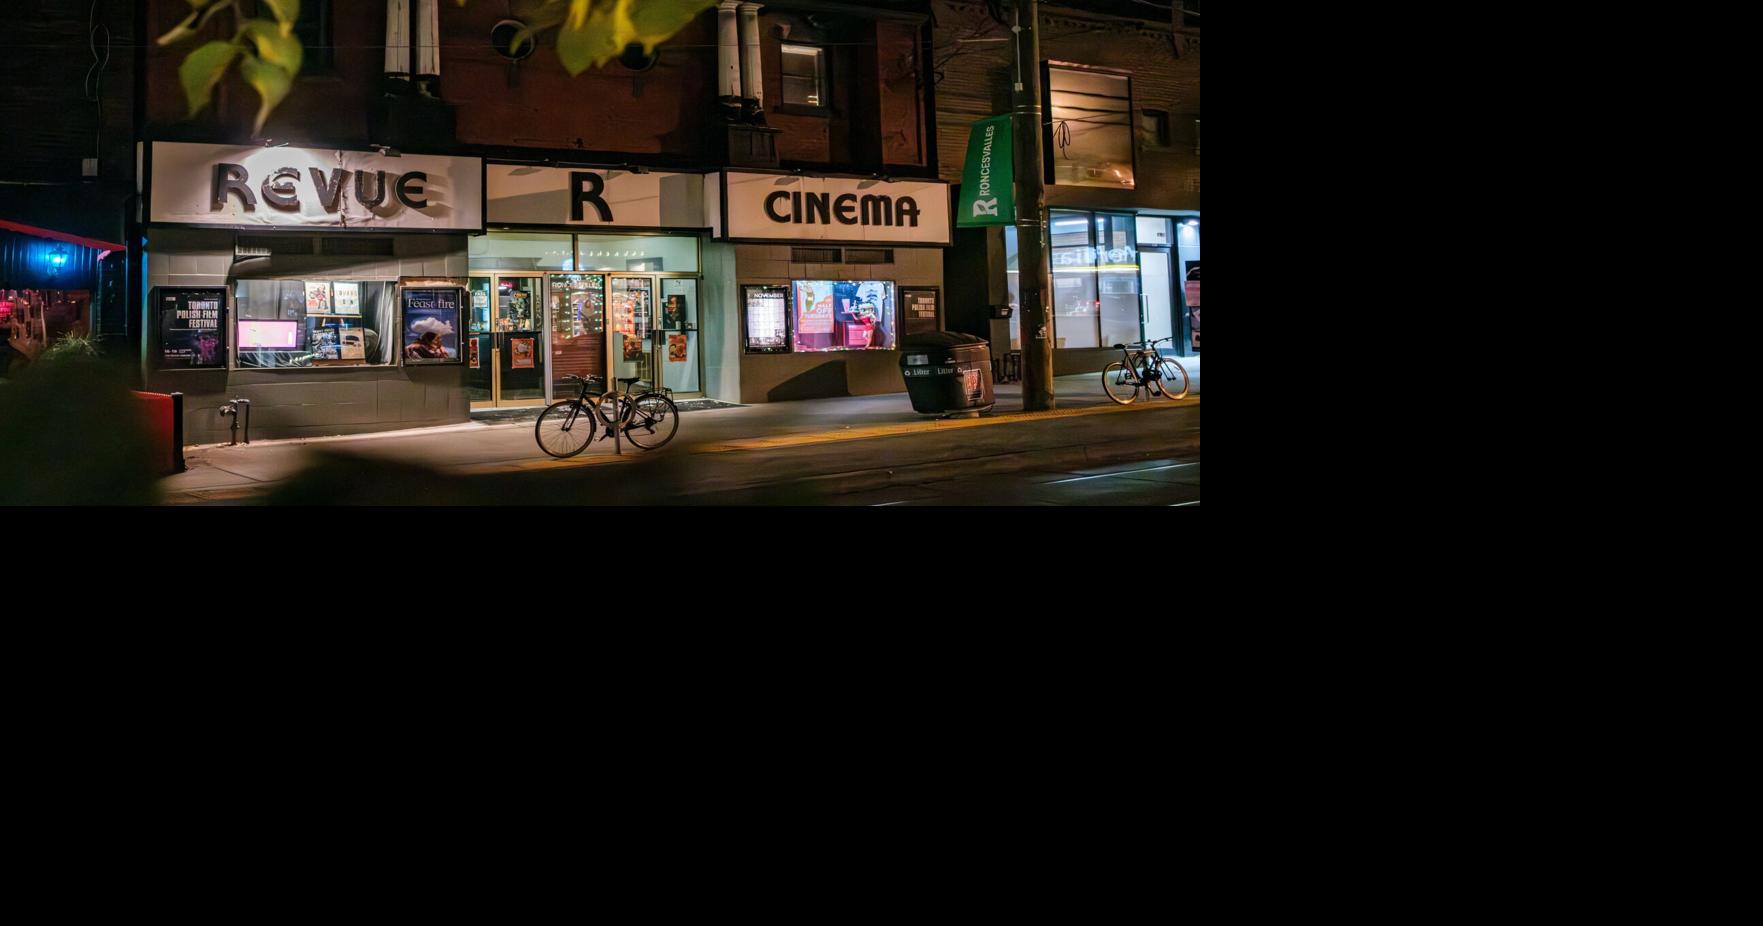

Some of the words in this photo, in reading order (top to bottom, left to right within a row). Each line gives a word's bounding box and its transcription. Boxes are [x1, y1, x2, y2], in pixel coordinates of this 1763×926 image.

[979, 125, 994, 196] RONCESVALLES
[216, 162, 428, 209] REVUE
[571, 171, 614, 222] R
[763, 190, 920, 227] CINEMA
[176, 310, 201, 319] POLISH
[202, 310, 219, 319] FILM
[188, 301, 219, 310] TORONTO
[408, 298, 435, 309] Feast
[438, 298, 455, 309] fire
[188, 319, 218, 328] FESTIVAL
